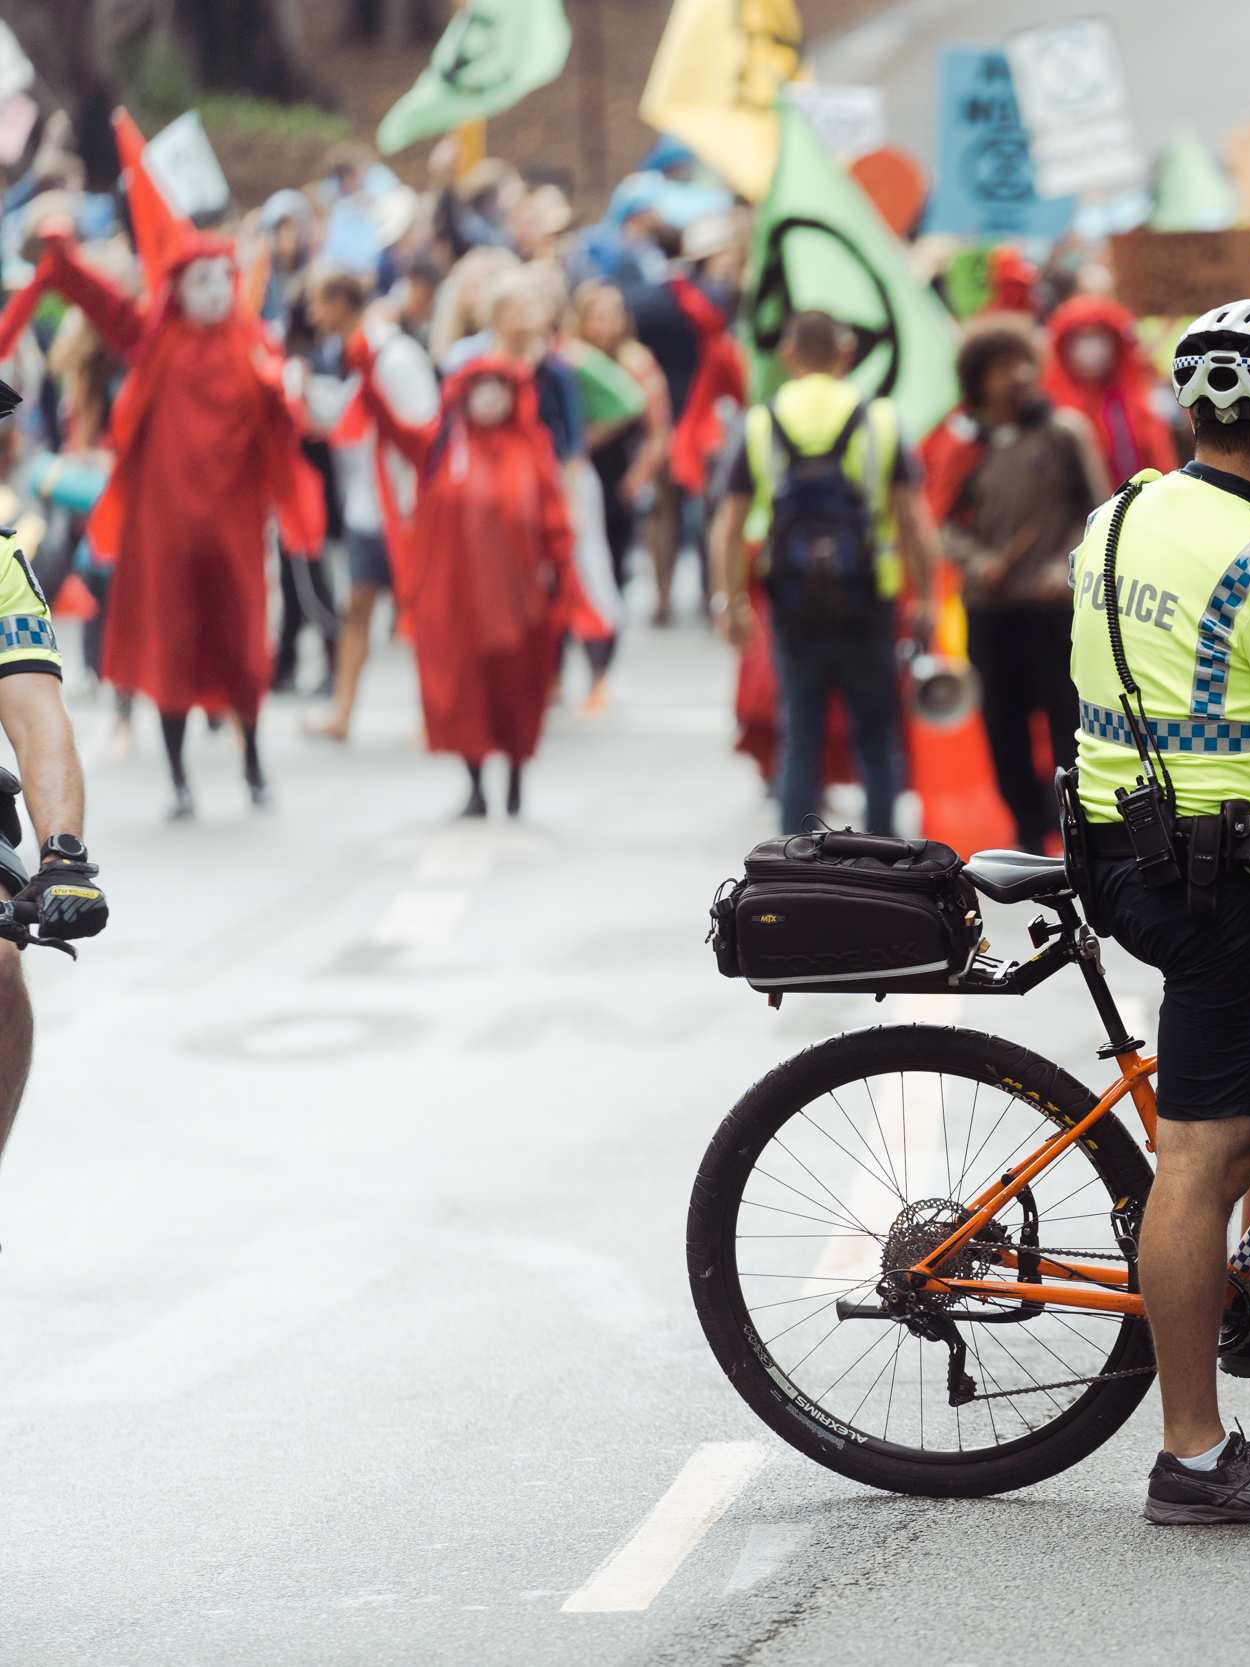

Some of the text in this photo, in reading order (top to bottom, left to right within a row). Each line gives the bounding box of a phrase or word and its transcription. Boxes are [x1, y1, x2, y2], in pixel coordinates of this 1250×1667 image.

[1079, 570, 1180, 633] POLICE
[760, 914, 777, 923] MTX
[1001, 1077, 1099, 1150] MAXXS
[795, 1395, 869, 1444] ALEXRIMS
